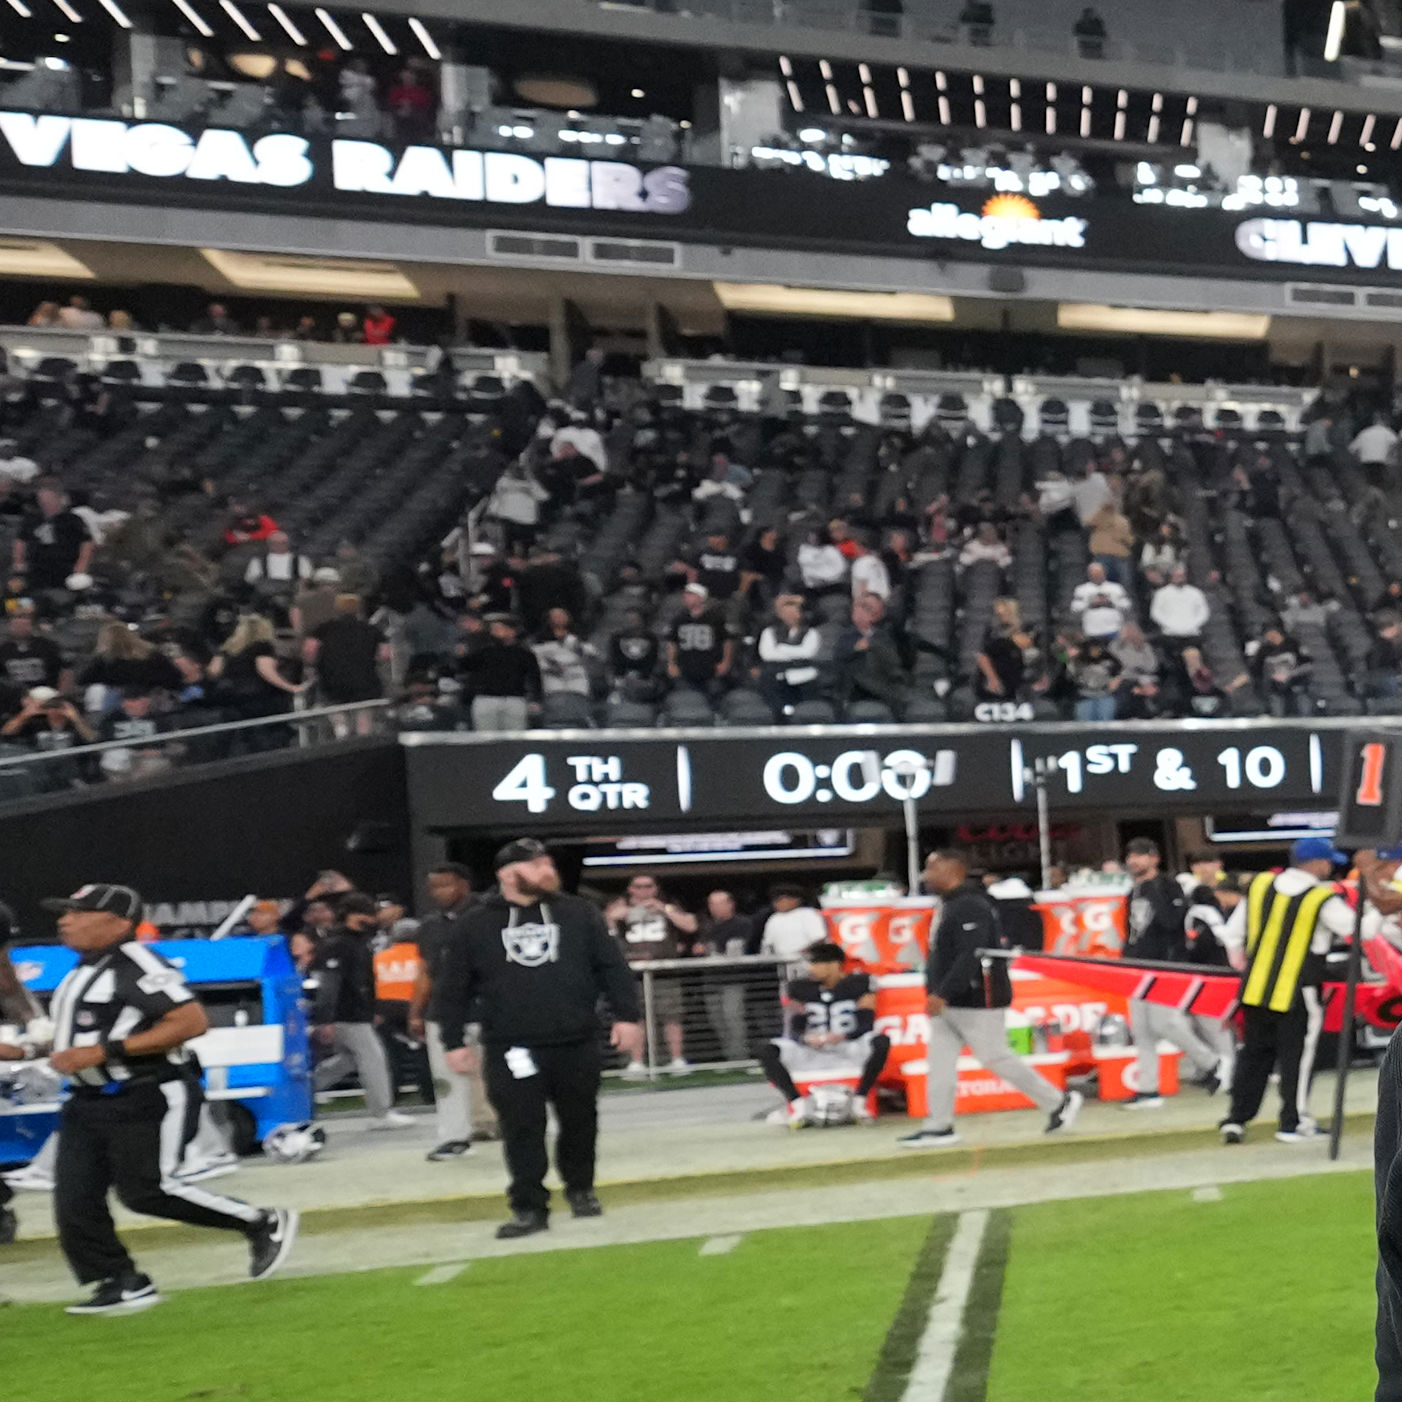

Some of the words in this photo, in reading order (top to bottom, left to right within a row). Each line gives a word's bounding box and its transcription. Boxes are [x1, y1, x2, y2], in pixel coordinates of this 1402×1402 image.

[0, 111, 313, 187] VEGAS
[332, 139, 692, 214] RAIDERS
[492, 753, 556, 813] 4
[566, 755, 622, 783] TH
[567, 782, 651, 812] QTR
[1153, 748, 1197, 790] &
[1217, 746, 1285, 789] 10
[1356, 743, 1386, 806] 1
